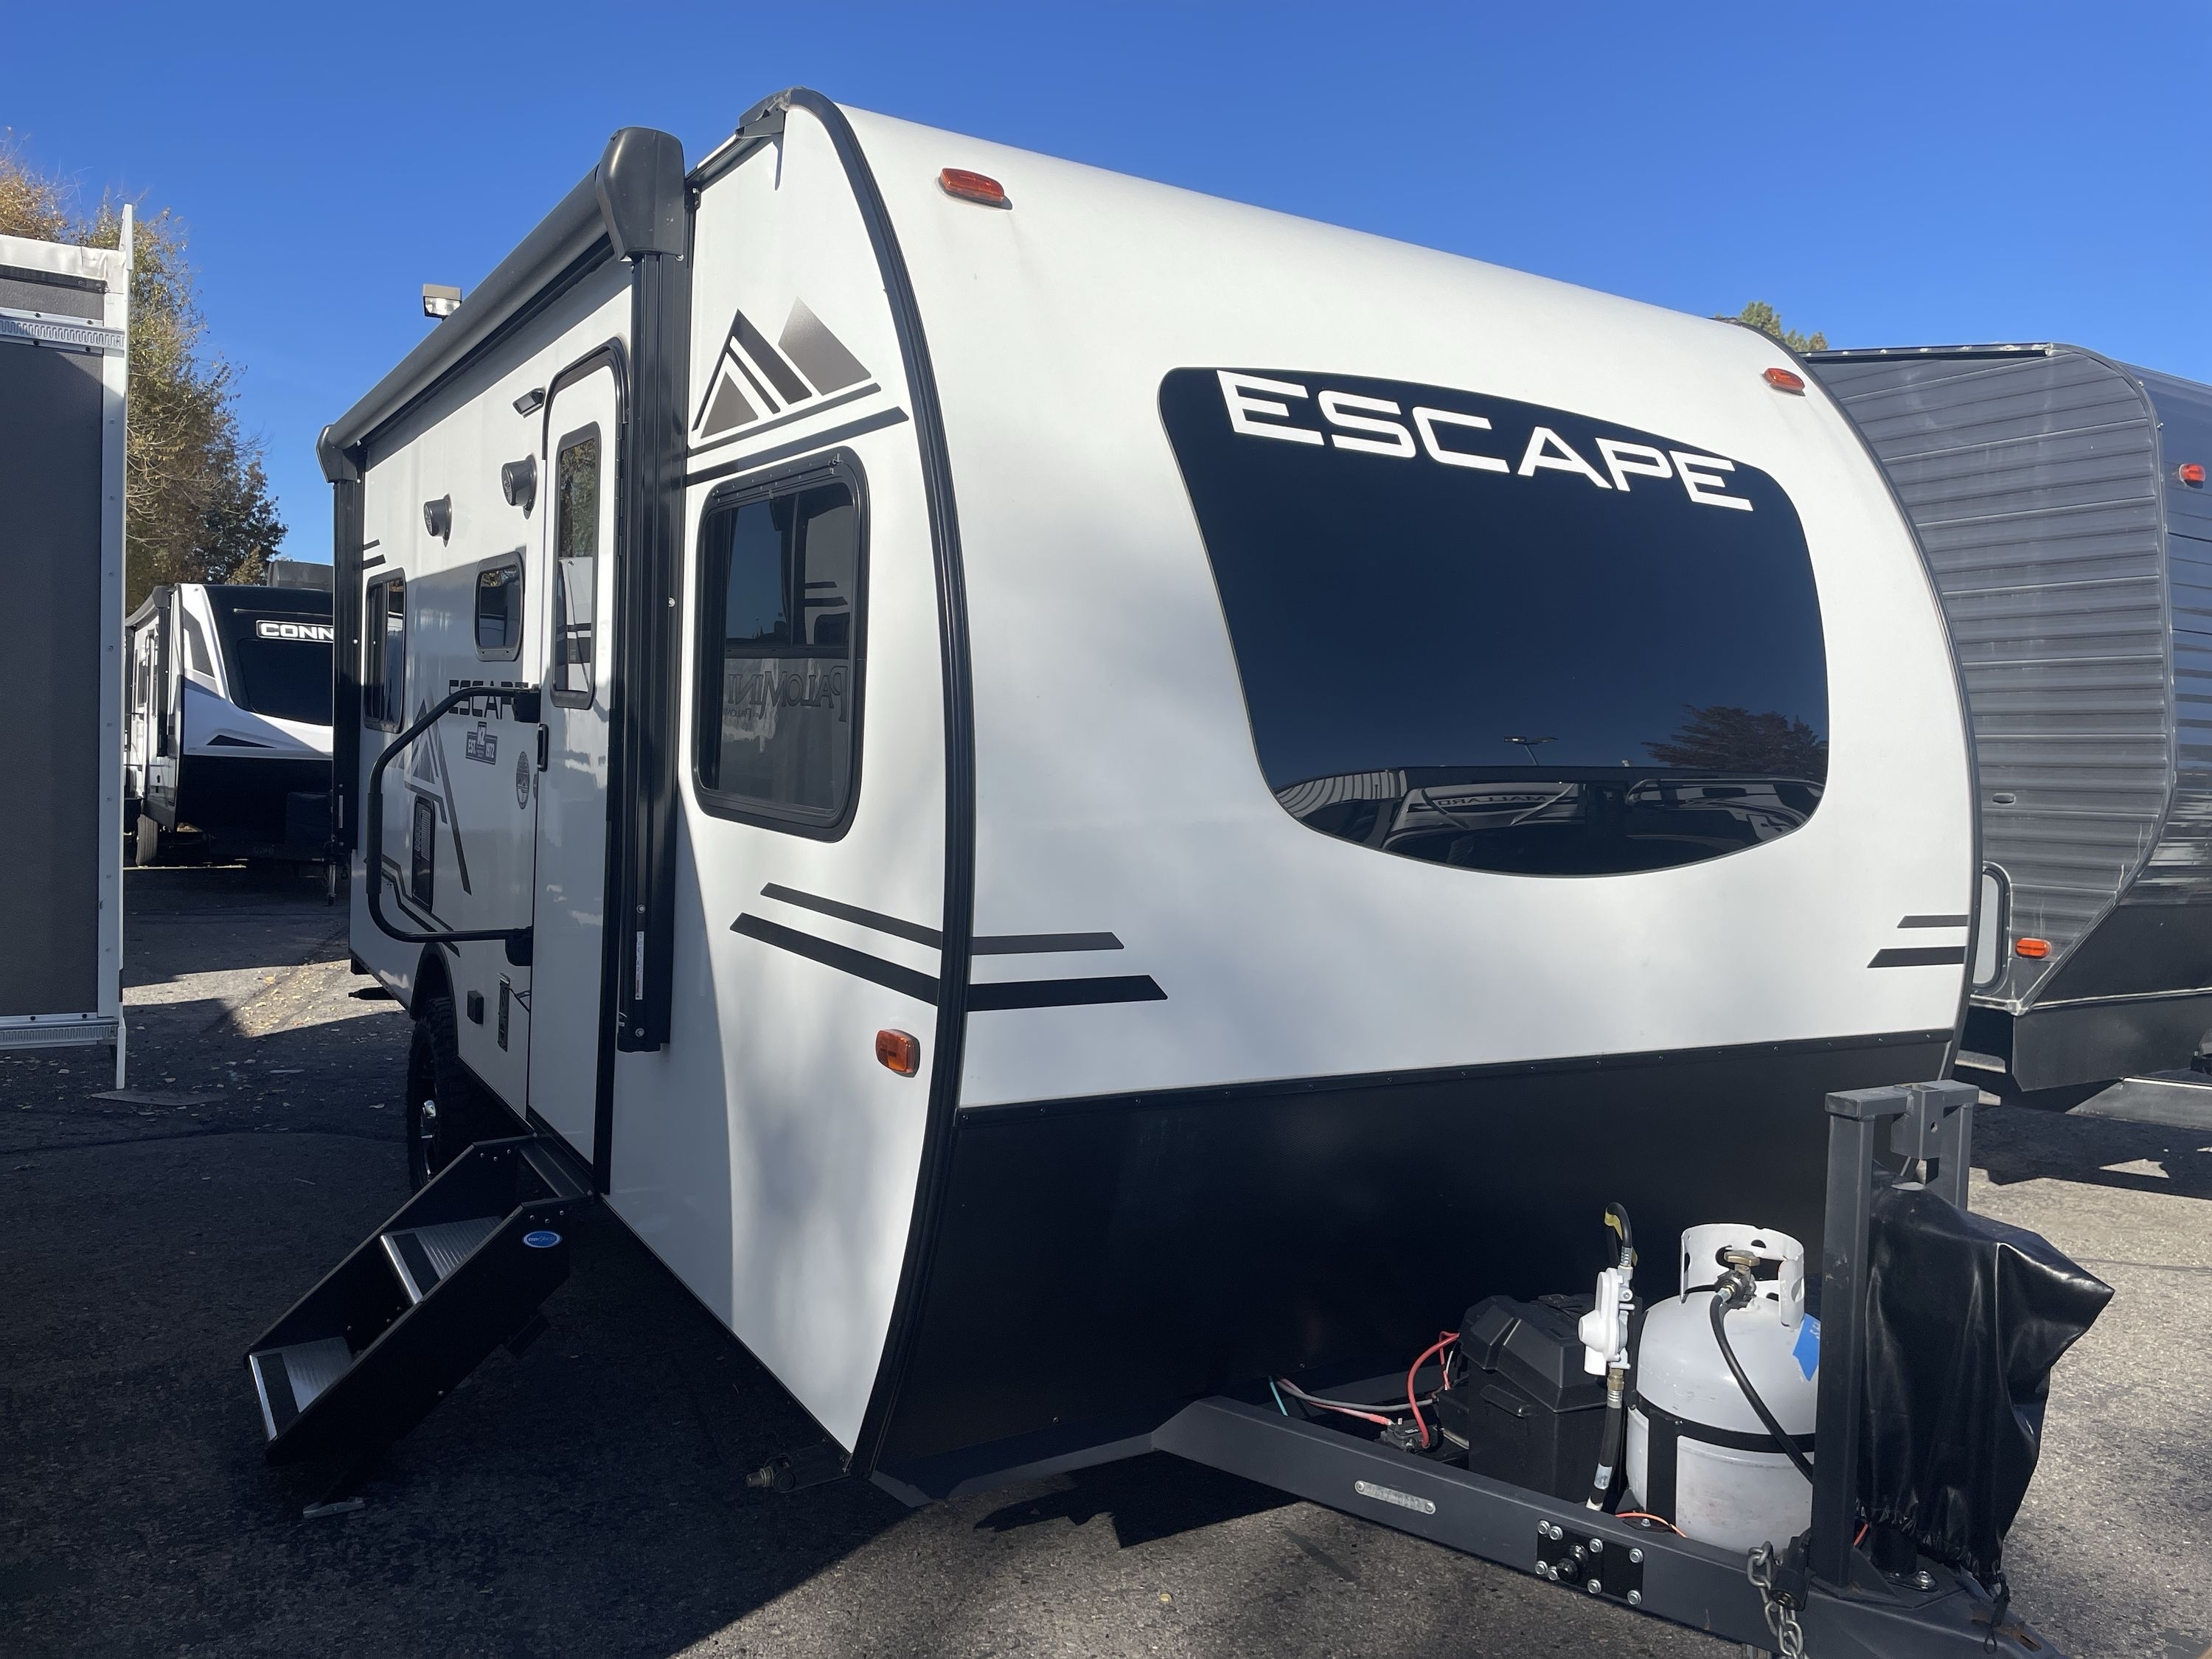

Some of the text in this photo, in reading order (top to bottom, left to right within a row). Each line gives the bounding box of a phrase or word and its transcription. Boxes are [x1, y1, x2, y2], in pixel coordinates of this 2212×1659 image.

[1217, 370, 1753, 512] ESCAPE
[261, 623, 333, 640] CONN
[448, 680, 529, 720] ESCAP
